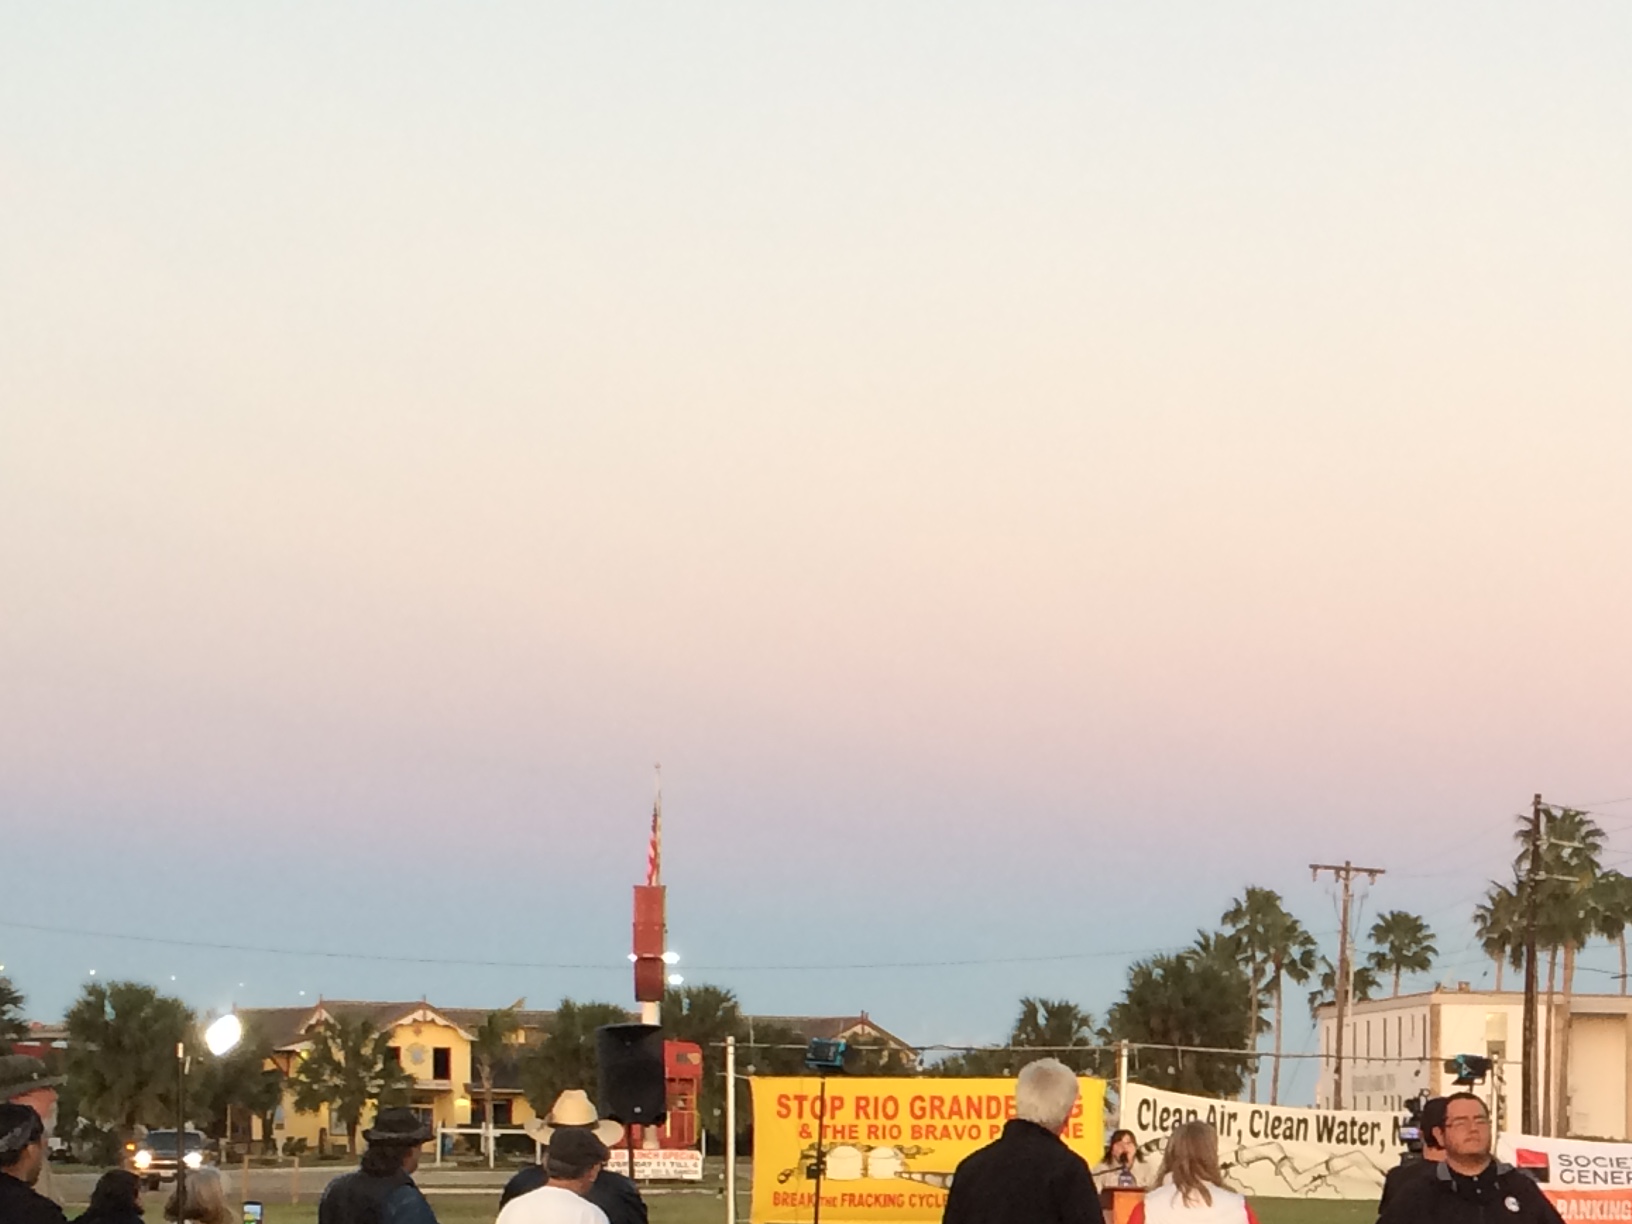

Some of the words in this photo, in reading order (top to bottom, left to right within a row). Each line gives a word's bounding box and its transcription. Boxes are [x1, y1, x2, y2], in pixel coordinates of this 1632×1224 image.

[776, 1094, 845, 1120] STOP
[855, 1095, 900, 1120] RIO
[910, 1095, 1016, 1120] GRANDE
[821, 1123, 859, 1140] THE
[866, 1124, 902, 1139] RIO
[911, 1124, 981, 1141] BRAVO
[1249, 1109, 1309, 1143] Clean
[1315, 1114, 1386, 1153] Water,
[772, 1192, 815, 1208] BREAK
[841, 1193, 905, 1208] FRACKING
